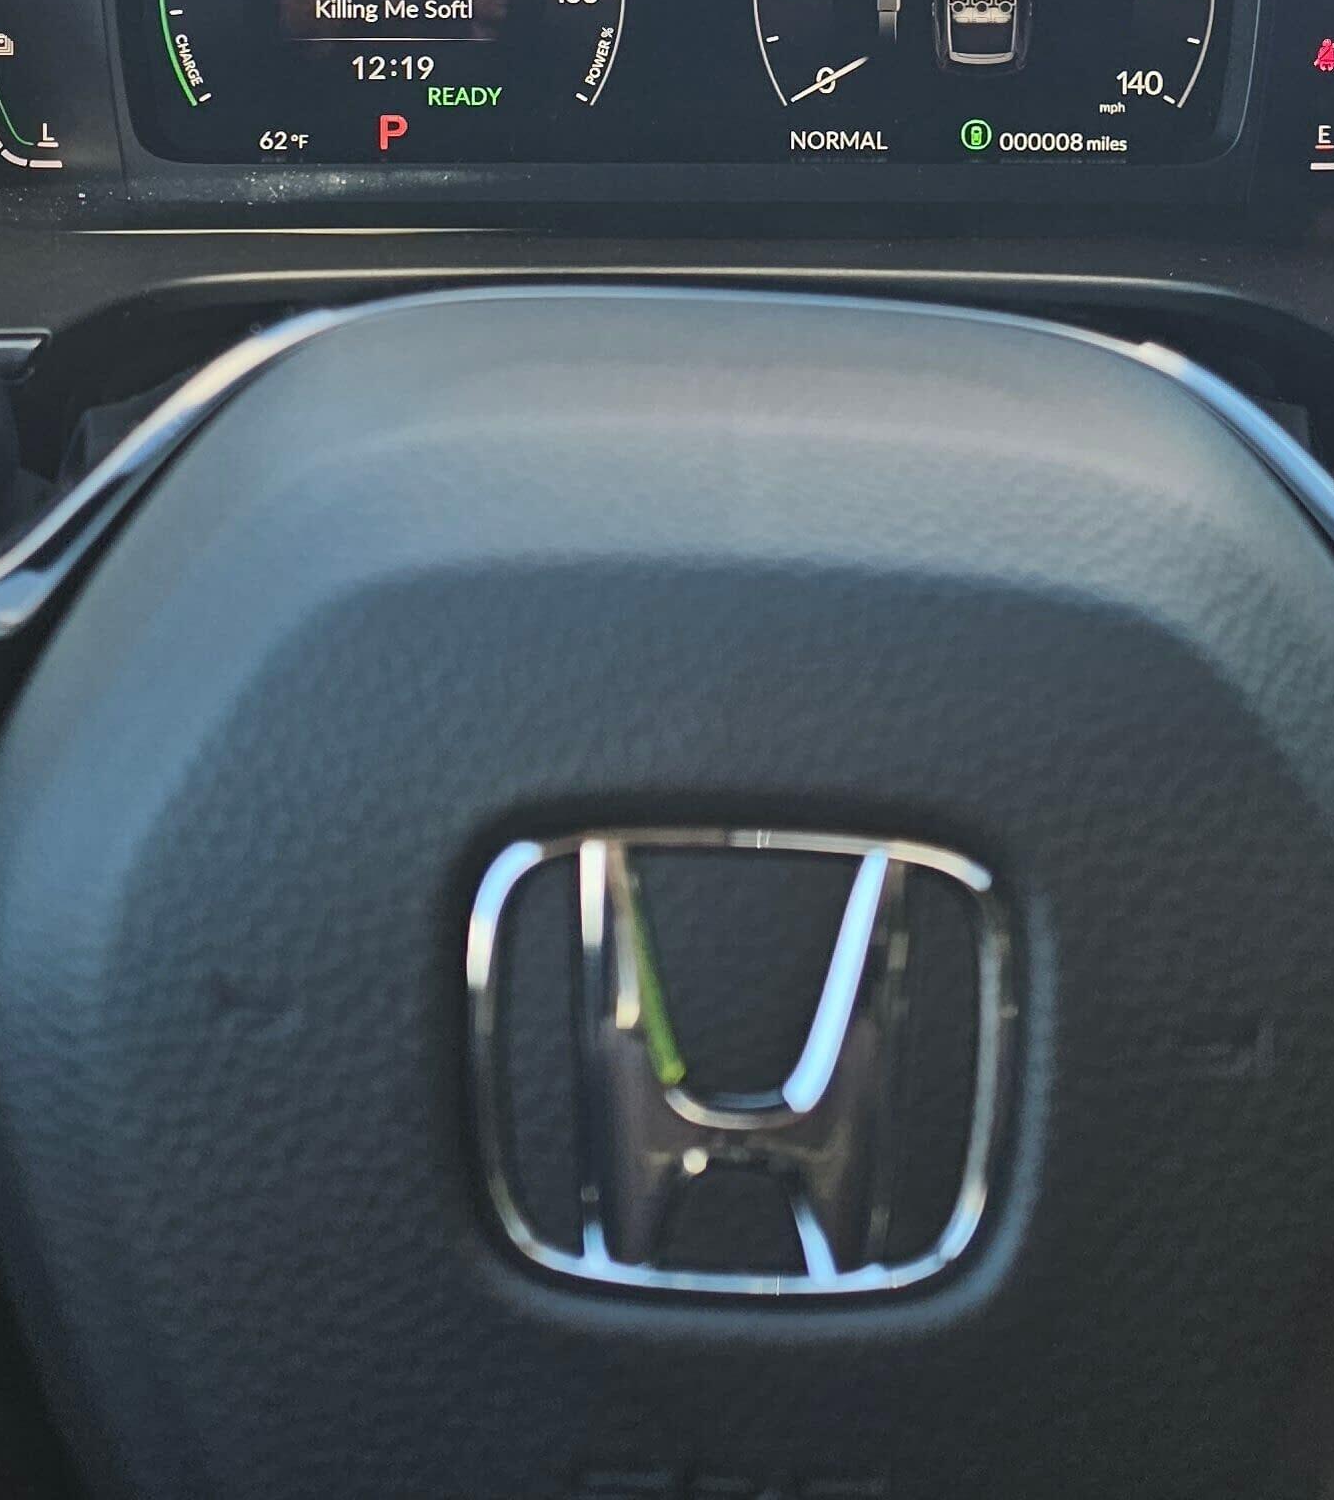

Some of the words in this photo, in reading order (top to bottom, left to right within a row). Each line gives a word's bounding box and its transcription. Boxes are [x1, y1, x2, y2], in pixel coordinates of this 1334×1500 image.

[315, 0, 379, 23] Killing
[384, 0, 420, 19] Me
[424, 0, 473, 19] Softl
[175, 33, 203, 87] CHARGE
[352, 55, 435, 80] 12:19
[584, 40, 612, 87] POWER
[1116, 70, 1164, 96] 140
[428, 86, 503, 106] READY
[1099, 101, 1126, 115] mph
[42, 122, 55, 141] L
[379, 114, 408, 150] P
[790, 130, 889, 150] NORMAL
[999, 132, 1084, 152] 000008
[1086, 134, 1128, 152] miles
[1317, 125, 1332, 143] E
